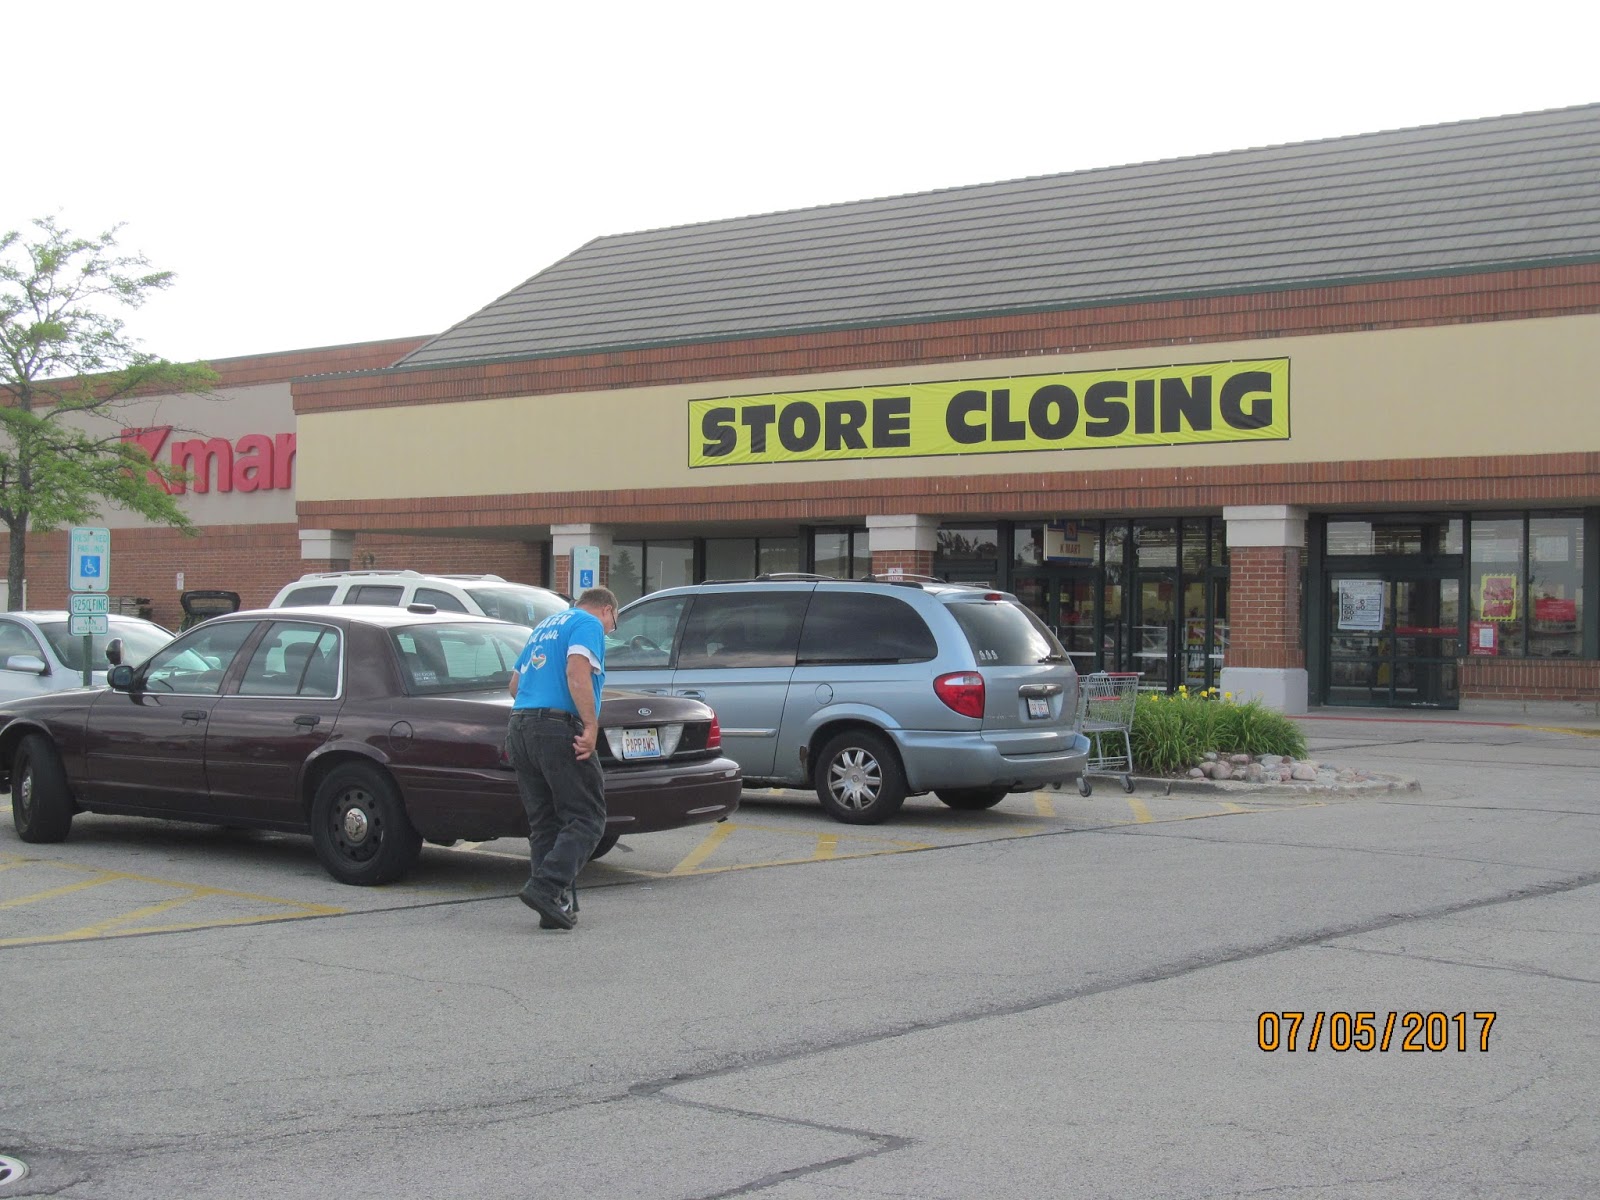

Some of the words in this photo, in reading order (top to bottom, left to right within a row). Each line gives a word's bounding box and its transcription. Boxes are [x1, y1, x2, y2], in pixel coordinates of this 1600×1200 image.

[702, 396, 911, 457] STORE
[945, 371, 1273, 445] CLOSING
[77, 545, 104, 554] PARNG
[75, 598, 91, 611] $250
[93, 598, 107, 611] FINE
